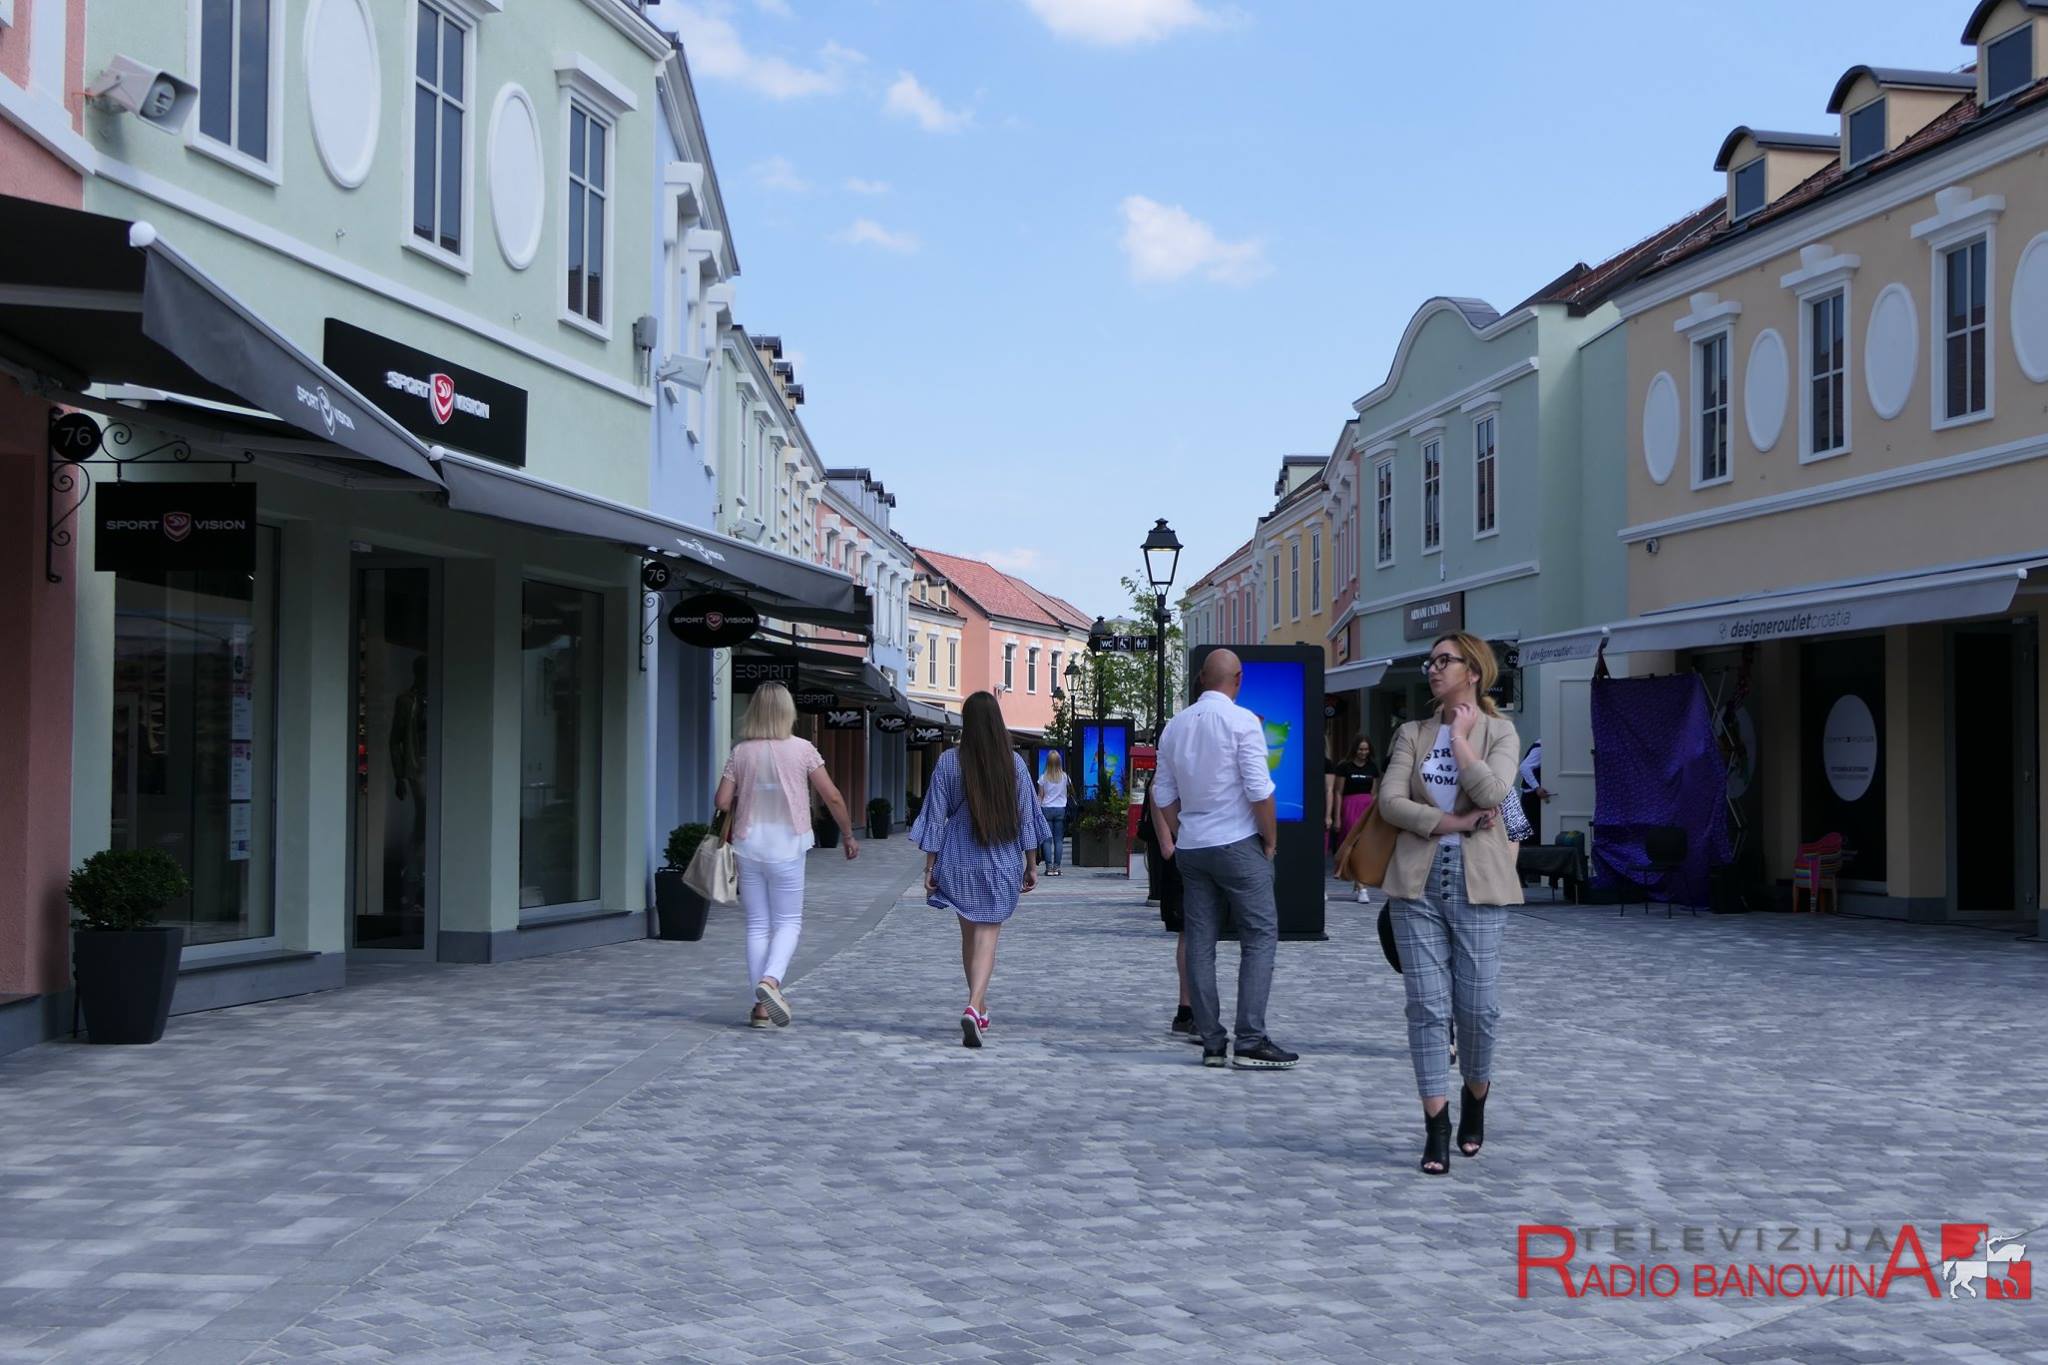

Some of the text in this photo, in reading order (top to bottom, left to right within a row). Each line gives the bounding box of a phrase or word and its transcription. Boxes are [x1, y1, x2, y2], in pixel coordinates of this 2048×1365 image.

[296, 384, 319, 410] SPORT
[385, 371, 490, 419] SPORT VISION
[61, 427, 92, 447] 76
[106, 519, 246, 531] SPORT VISION
[648, 569, 666, 583] 76
[673, 616, 704, 624] SPORT
[1730, 608, 1851, 638] designeroutletcroatia
[1101, 640, 1113, 648] WC
[1507, 655, 1519, 664] 32
[735, 663, 795, 679] ESPRIT
[797, 693, 835, 705] ESPRIT
[1423, 747, 1455, 762] STR
[1436, 763, 1453, 772] AS
[1422, 773, 1457, 786] WOM
